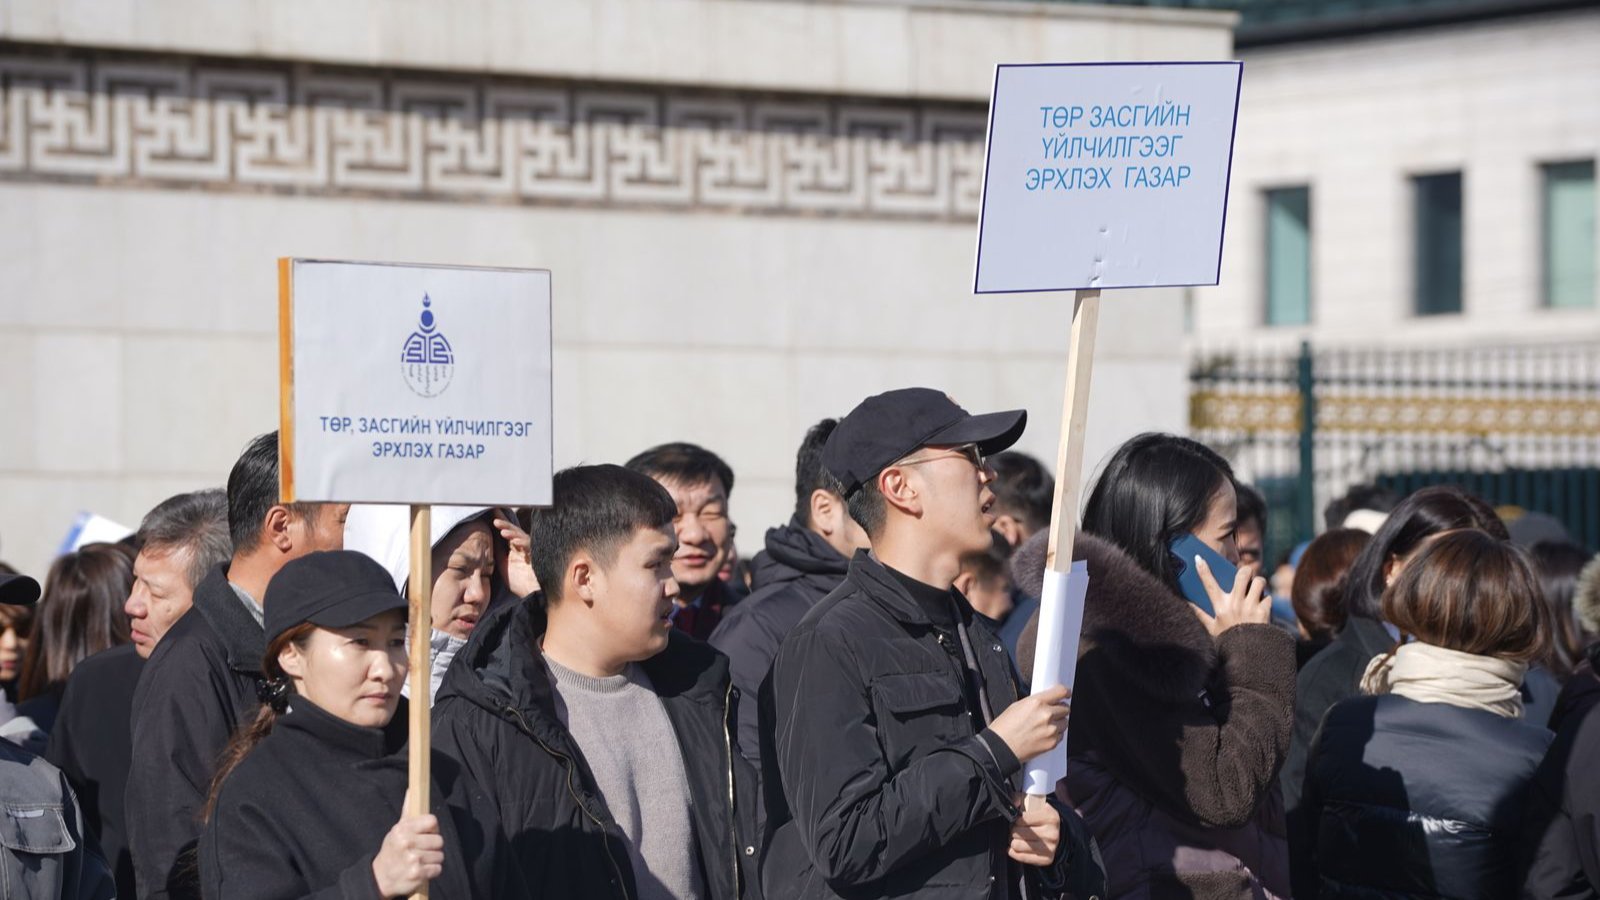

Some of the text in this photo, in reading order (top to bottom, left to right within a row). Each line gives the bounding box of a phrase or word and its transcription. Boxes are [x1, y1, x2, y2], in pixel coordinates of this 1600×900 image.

[1040, 100, 1190, 128] ТӨР ЗАСГИЙН
[1042, 132, 1183, 159] ҮЙЛЧИЛГЭЭГ
[1025, 166, 1191, 190] ЭРХЛЭХ ГАЗАР
[359, 415, 431, 434] ЗАСГИЙН
[435, 416, 533, 437] ҮЙЛЧИЛГЭЭГ
[372, 441, 485, 459] ЭРХЛЭХ ГАЗАР
